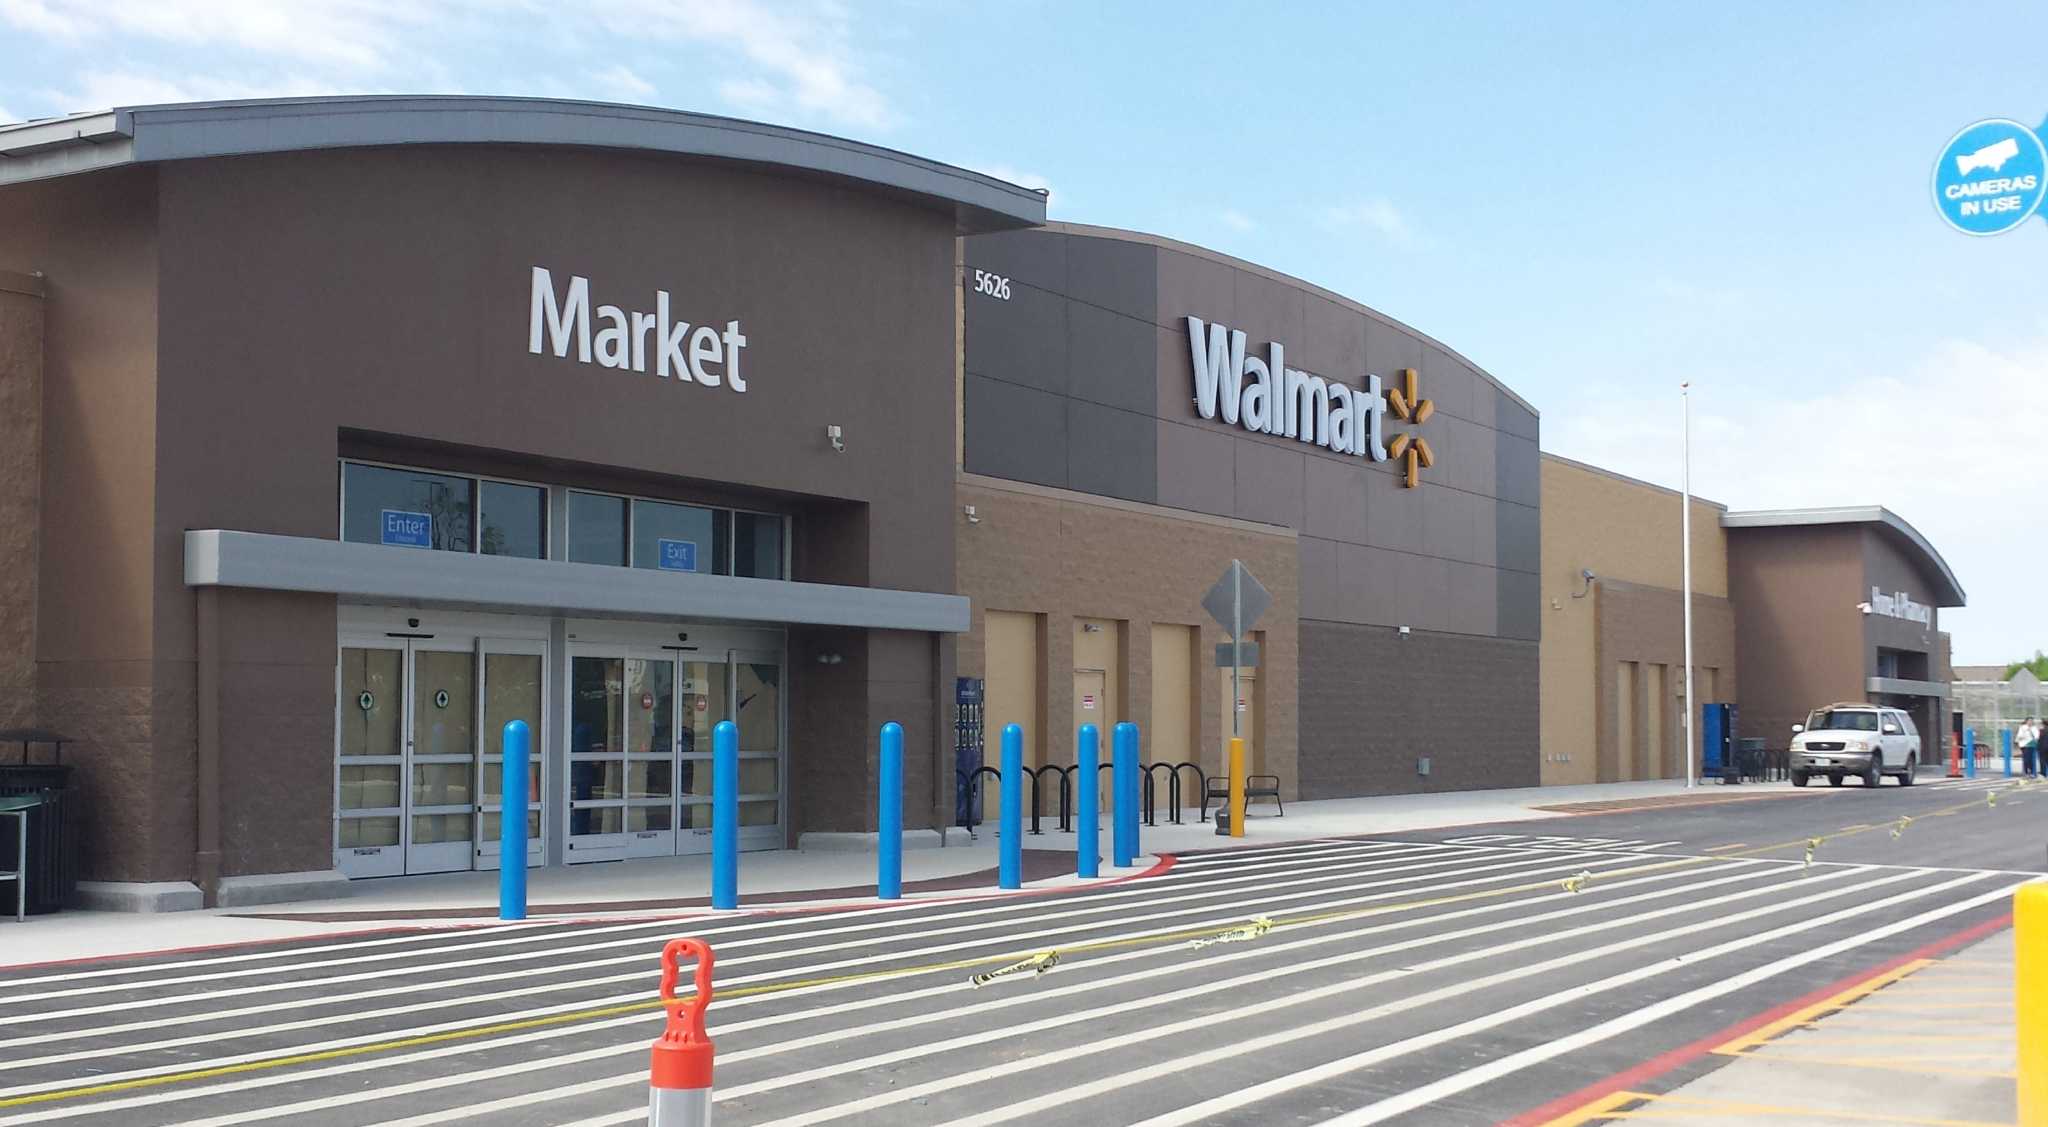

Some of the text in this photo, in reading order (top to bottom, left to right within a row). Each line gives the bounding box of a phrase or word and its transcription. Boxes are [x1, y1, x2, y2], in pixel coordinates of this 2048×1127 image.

[1945, 175, 2037, 199] CAMERAS
[1960, 195, 2022, 216] IN USE
[974, 269, 1011, 300] 5626
[529, 266, 746, 393] Market
[1186, 315, 1387, 463] Walmart
[388, 514, 425, 536] Enter
[667, 543, 688, 561] Exit
[1442, 834, 1683, 852] YIELD
